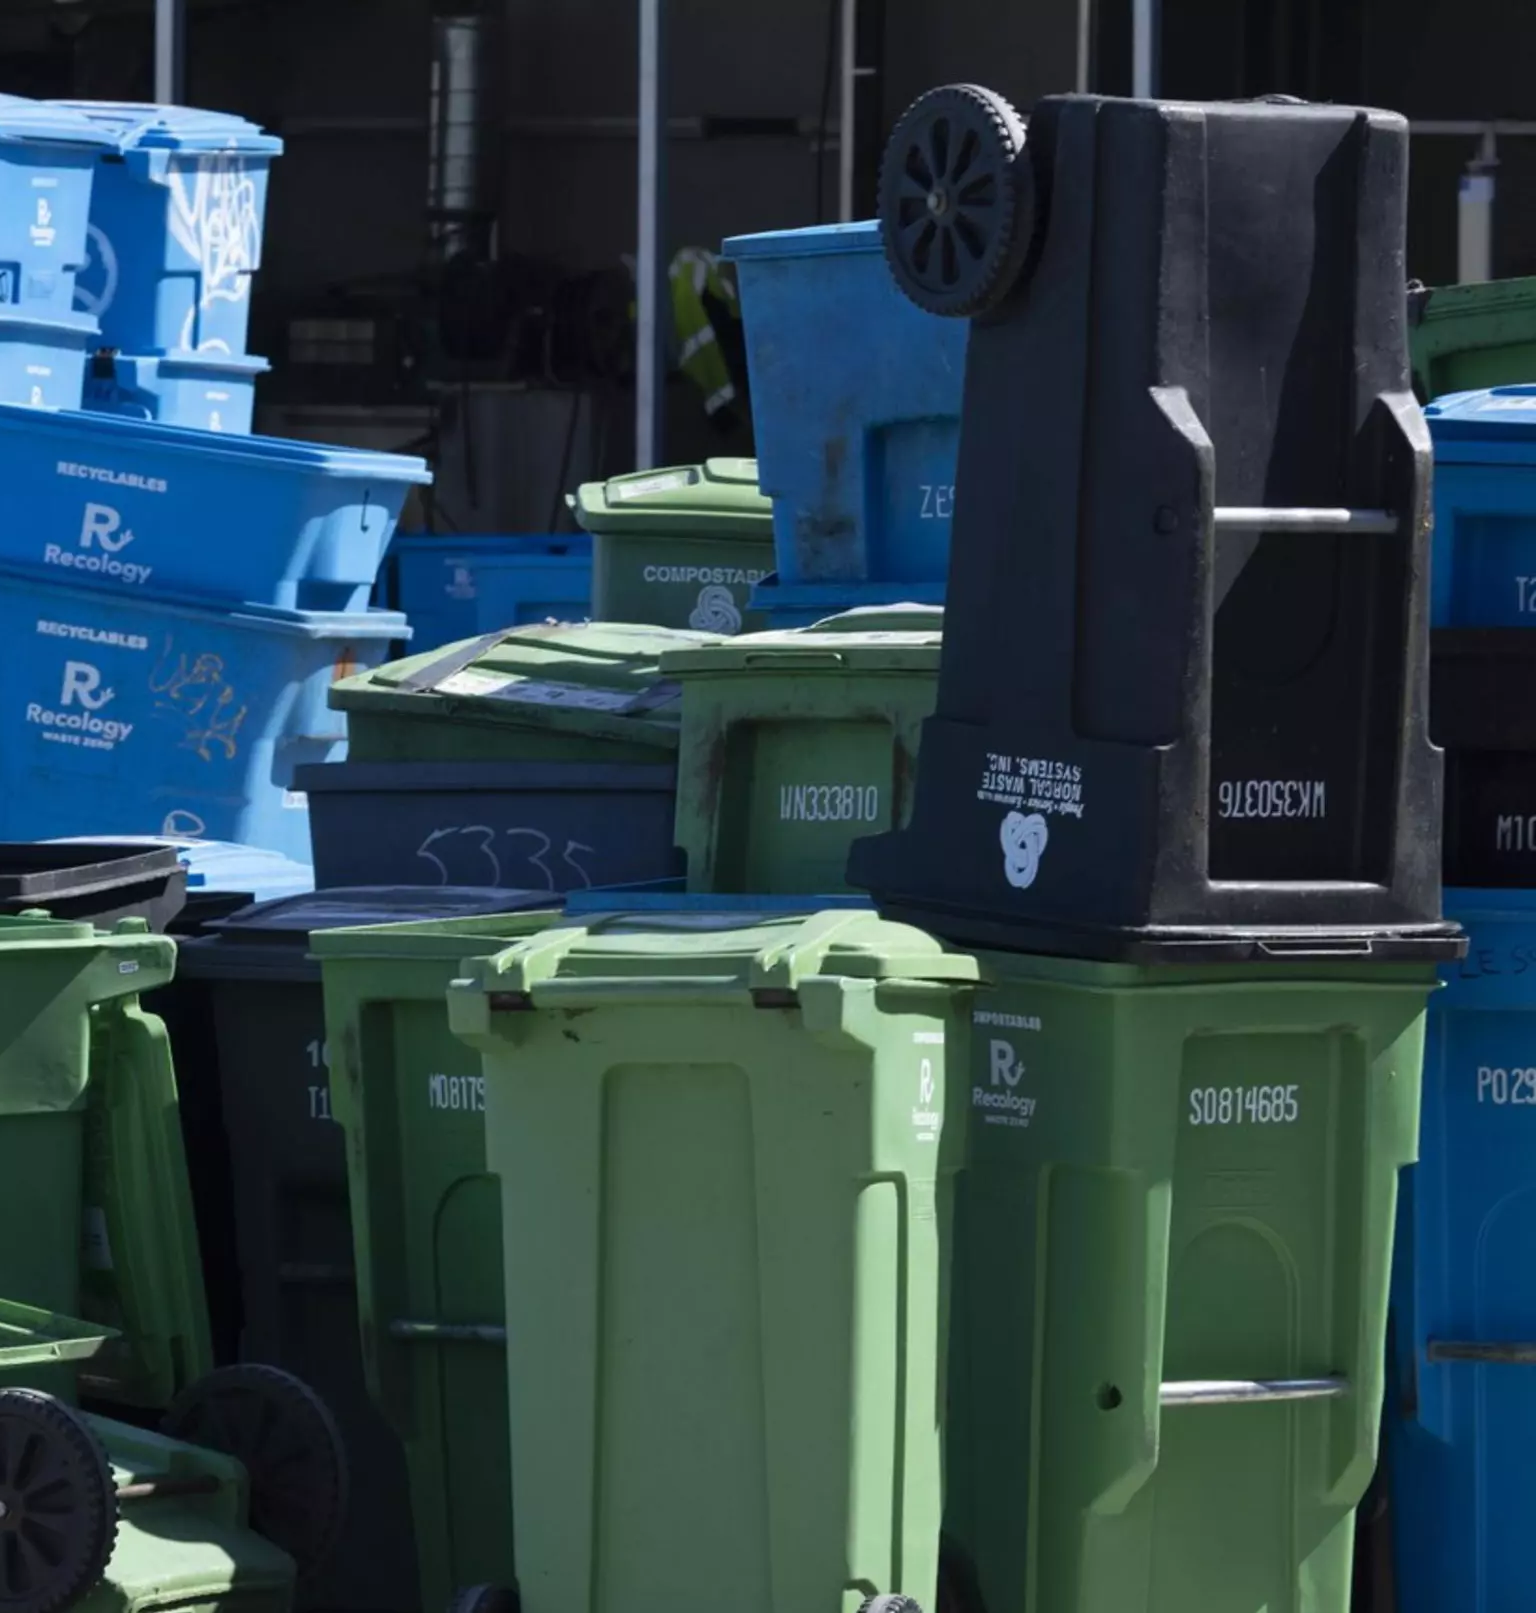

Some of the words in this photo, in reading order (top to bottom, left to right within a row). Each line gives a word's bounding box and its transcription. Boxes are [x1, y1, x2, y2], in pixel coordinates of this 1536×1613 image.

[57, 461, 168, 493] RECYCLABLES
[79, 503, 135, 552] R
[44, 543, 152, 585] Recology
[37, 619, 149, 651] RECYCLABLES
[61, 661, 115, 710] R
[26, 702, 134, 742] Recology
[986, 752, 1012, 773] INC.
[1015, 756, 1082, 782] SYSTEMS,
[982, 772, 1024, 795] WASTE
[1029, 777, 1082, 801] NORCAL
[1217, 780, 1324, 819] WK350376
[990, 1039, 1025, 1087] R
[972, 1087, 1036, 1117] Recology
